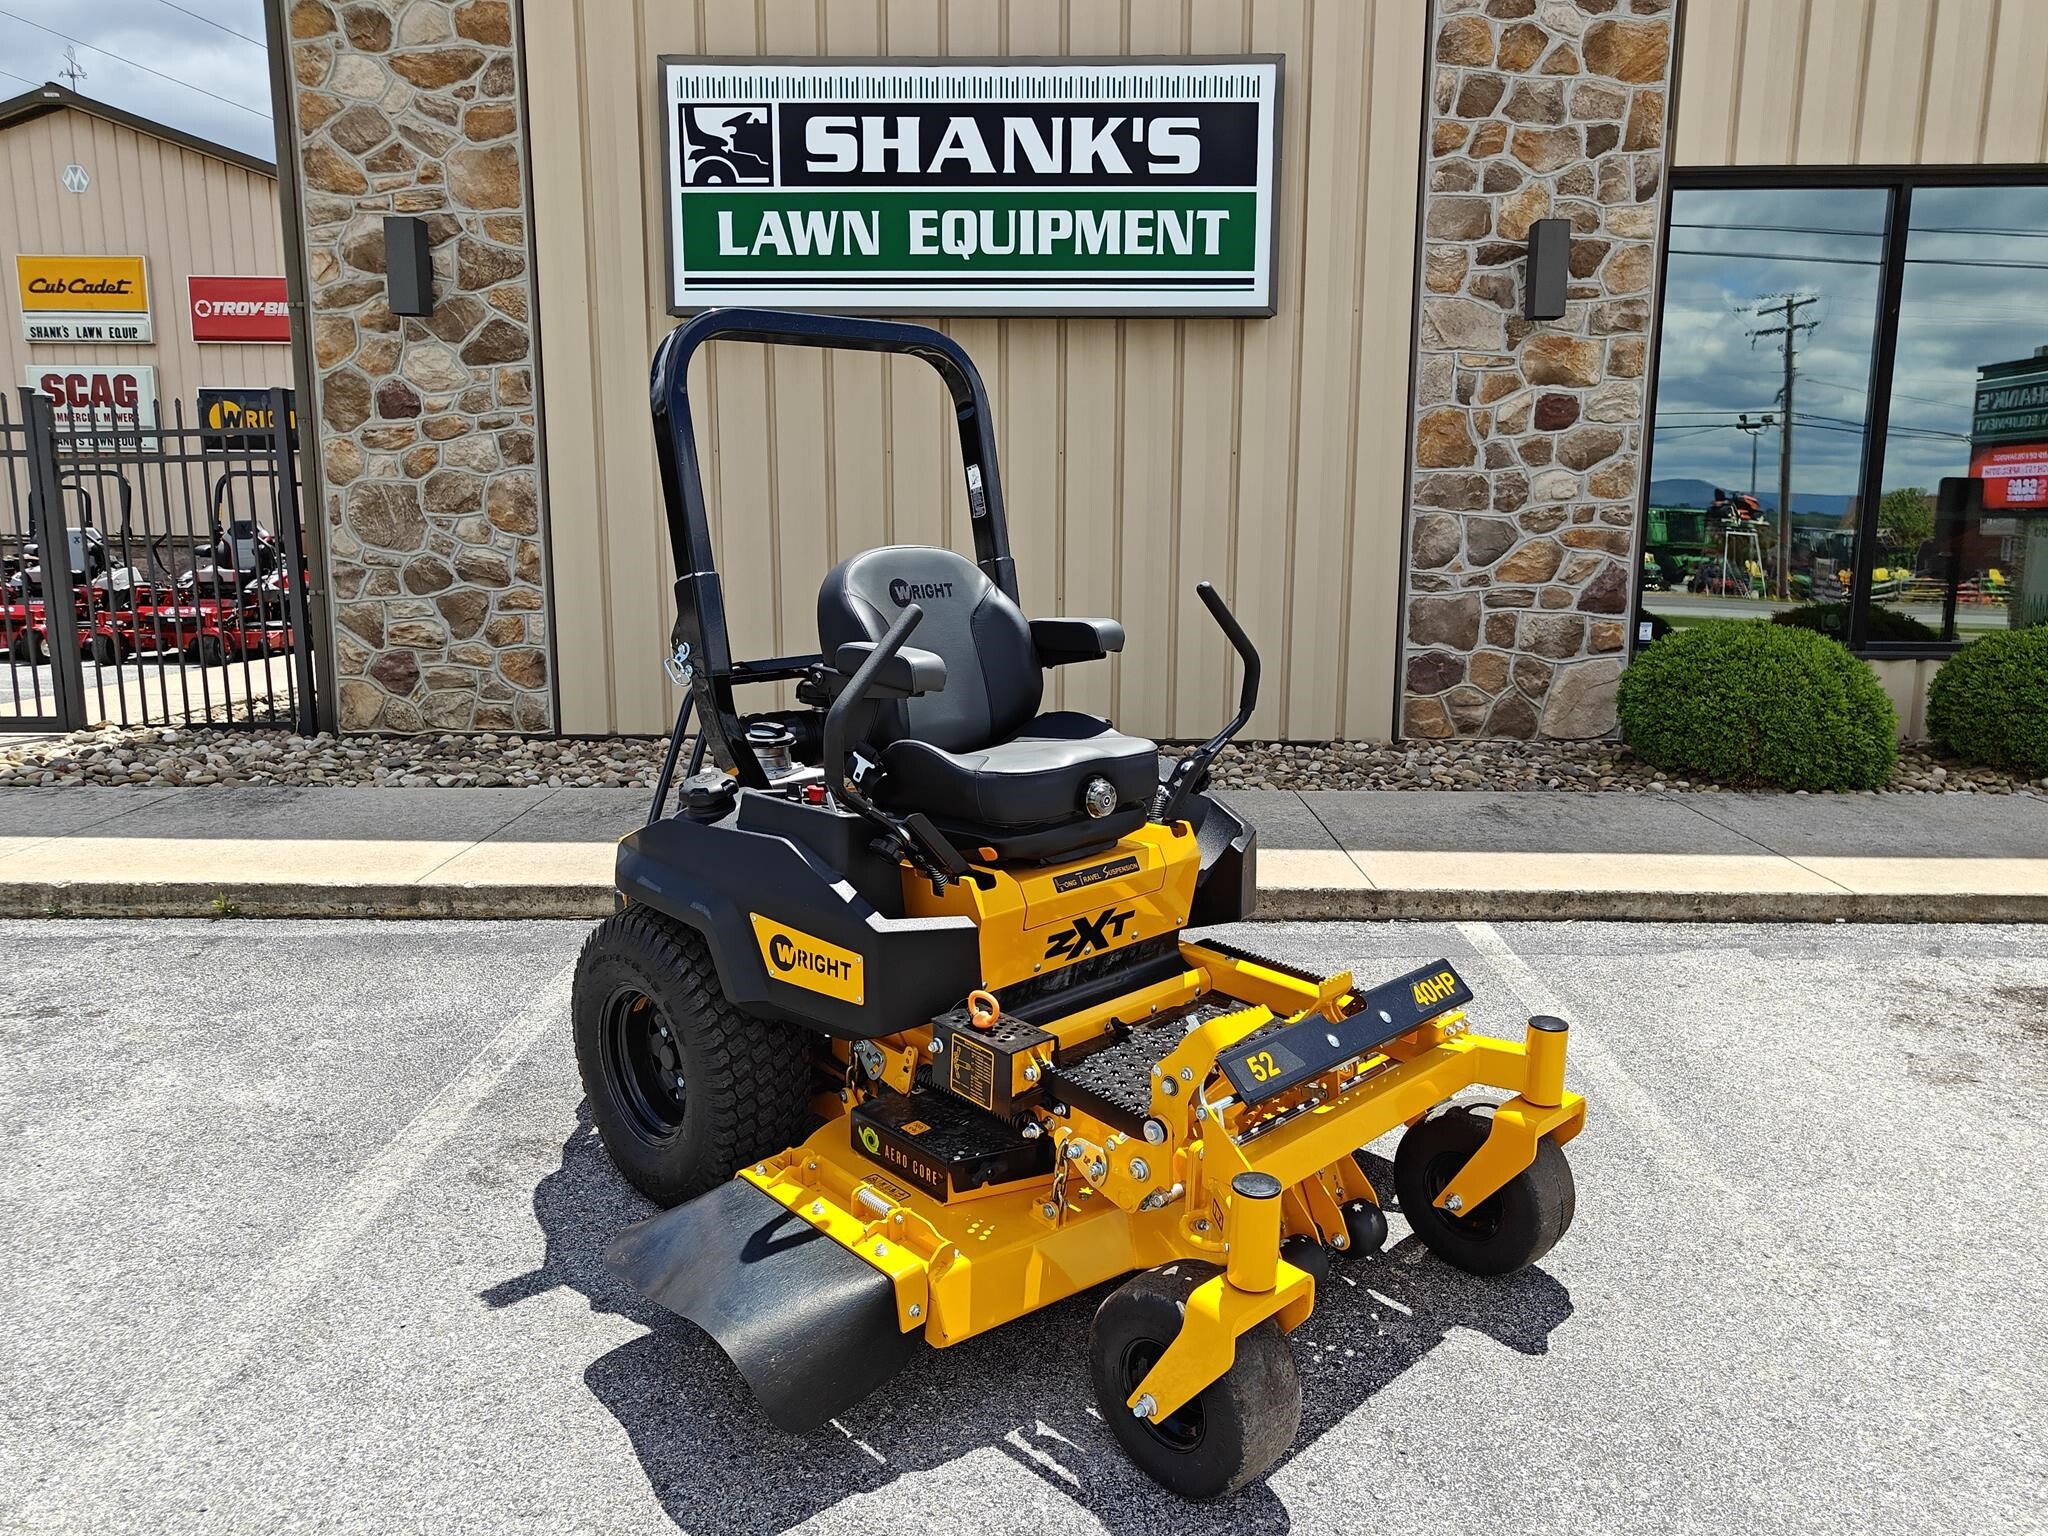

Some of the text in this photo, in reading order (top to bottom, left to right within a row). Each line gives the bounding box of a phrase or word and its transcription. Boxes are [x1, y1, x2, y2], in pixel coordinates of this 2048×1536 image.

[806, 115, 1201, 174] SHANK'S
[717, 209, 1230, 260] LAWN EQUIPMENT
[28, 278, 66, 294] Cub
[30, 325, 70, 338] SHANK'S
[76, 326, 102, 339] LAWN
[41, 374, 138, 408] SCAG
[889, 578, 953, 608] WRIGHT
[1054, 863, 1139, 891] LONG TRAVEL SUSPENSION
[769, 933, 852, 981] WRIGHT
[1413, 972, 1456, 1006] 40HP
[1246, 1051, 1281, 1082] 52
[884, 1144, 908, 1168] AERO
